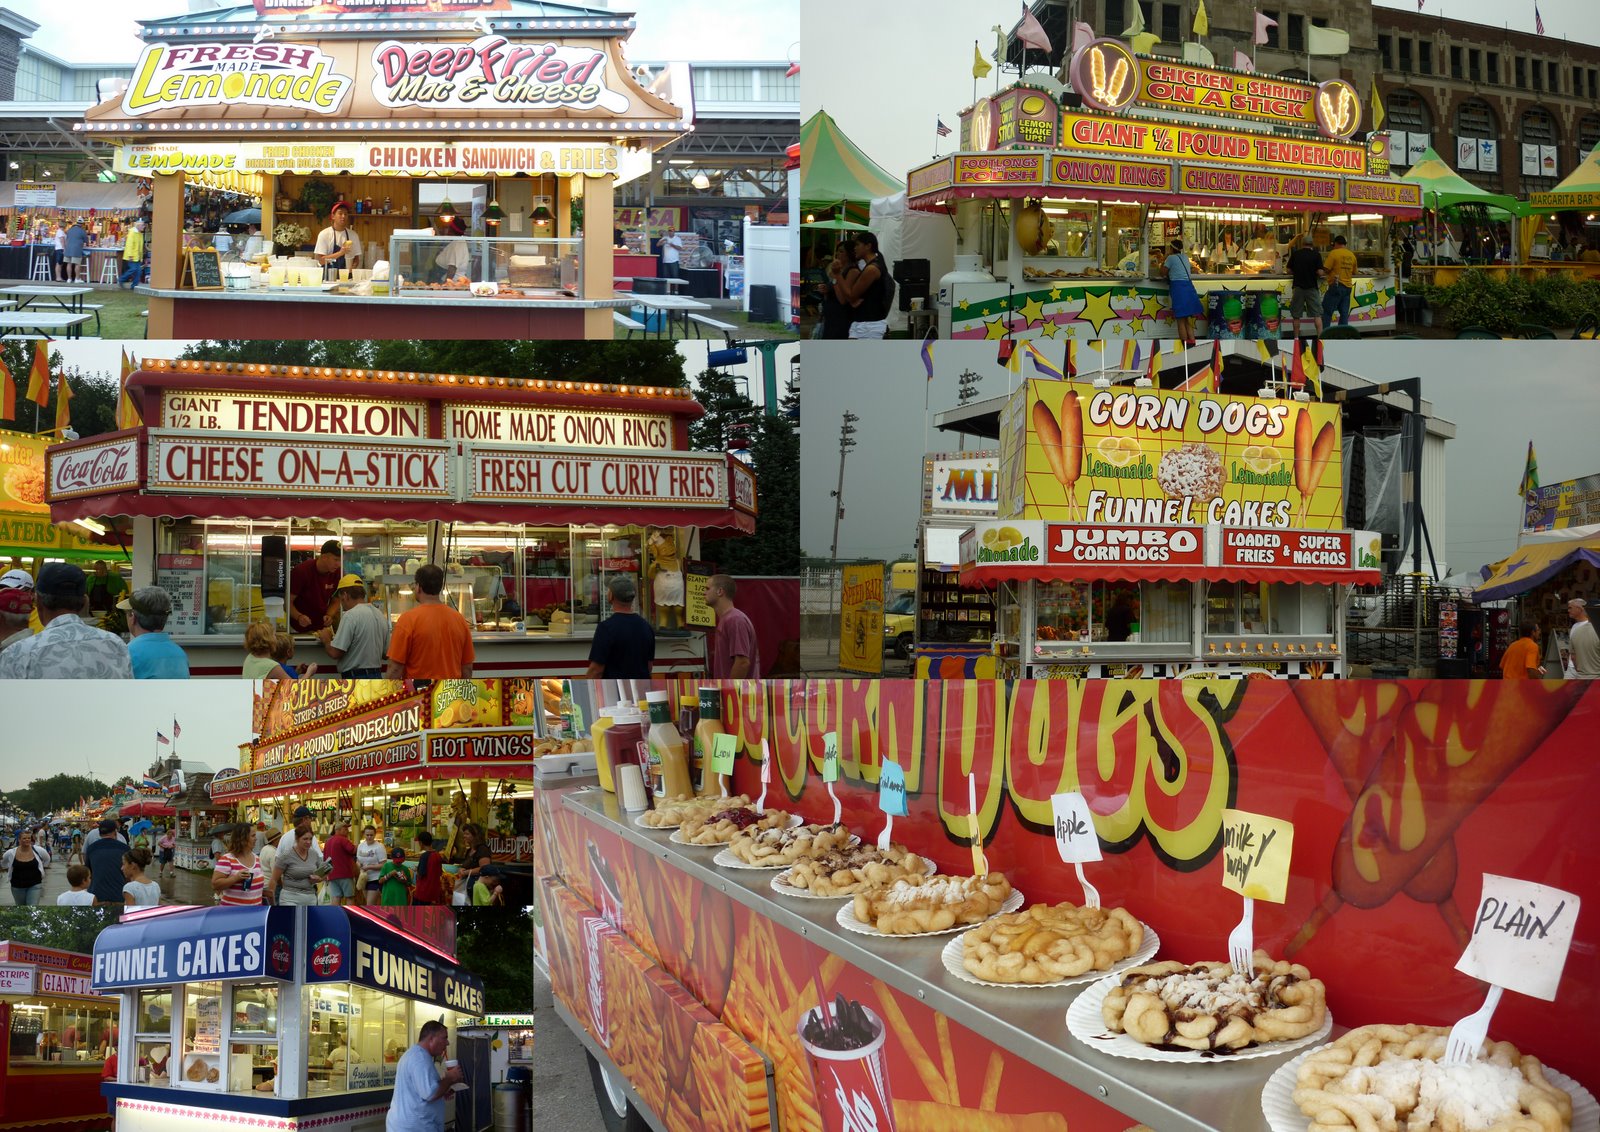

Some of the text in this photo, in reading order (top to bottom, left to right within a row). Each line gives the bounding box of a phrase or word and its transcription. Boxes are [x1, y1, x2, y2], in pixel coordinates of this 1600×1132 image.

[162, 45, 315, 70] FRESH
[212, 62, 260, 72] MADE
[377, 38, 603, 87] Deep Fried
[129, 47, 342, 109] Lemonade
[387, 75, 600, 103] Mac & Cheese
[1148, 65, 1312, 101] CHICKEN SHRIMP
[1148, 82, 1305, 118] ON A STICK
[998, 121, 1015, 144] STICK
[1019, 120, 1053, 129] LEMON
[1019, 127, 1052, 136] SHAKE
[1025, 134, 1046, 143] UPS!
[1073, 120, 1148, 148] GIANT
[1179, 132, 1250, 159] POUND
[1255, 139, 1362, 170] TENDERLOIN
[127, 152, 237, 169] LEMONADE
[245, 158, 276, 169] DINNER
[331, 158, 355, 168] FRIES
[291, 146, 335, 158] CHICKEN
[369, 147, 618, 170] CHICKEN SANDWICH & FRIES
[961, 158, 1038, 168] FOOTLONGS
[961, 171, 1037, 181] POLISH
[1056, 160, 1167, 188] ONION RINGS
[1185, 170, 1336, 198] CHICKEN STRIPS AND FRIES
[1531, 194, 1593, 205] MARGARITA BAR
[169, 397, 420, 437] GIANT TENDERLOIN
[170, 415, 222, 429] 1/2 LB.
[1090, 391, 1290, 437] CORN DOGS
[452, 409, 667, 449] HOME MADE ONION RINGS
[56, 445, 131, 490] Coca-Cola
[166, 445, 440, 489] CHEESE ON-A-STICK
[480, 458, 715, 498] FRESH CUT CURLY FRIES
[1087, 453, 1153, 480] Lemonade
[1231, 462, 1292, 487] Lemonade
[1544, 485, 1576, 498] Photos
[1087, 490, 1292, 528] FUNNEL CAKES
[1055, 529, 1198, 553] JUMBO
[1228, 533, 1341, 557] LOADED & SUPER
[1073, 546, 1169, 561] CORN DOGS
[1236, 549, 1346, 566] FRIES NACHOS
[277, 560, 285, 588] napkins
[691, 615, 710, 623] $8.00
[294, 694, 348, 725] STRIPS & FRIES
[263, 706, 420, 768] GIANT 1/2 POUND TENDERLOIN
[432, 735, 532, 757] HOT WINGS
[319, 742, 418, 771] FRESH POTATO CHIPS
[284, 764, 310, 781] BAR-B-Q
[320, 765, 343, 776] MADE
[399, 795, 427, 806] LEMON
[1056, 811, 1088, 840] Apple
[94, 932, 261, 984] FUNNEL CAKES
[44, 974, 77, 993] GIANT
[356, 940, 483, 1014] FUNNEL CAKES
[314, 999, 331, 1011] ICE
[338, 1003, 355, 1015] TEA
